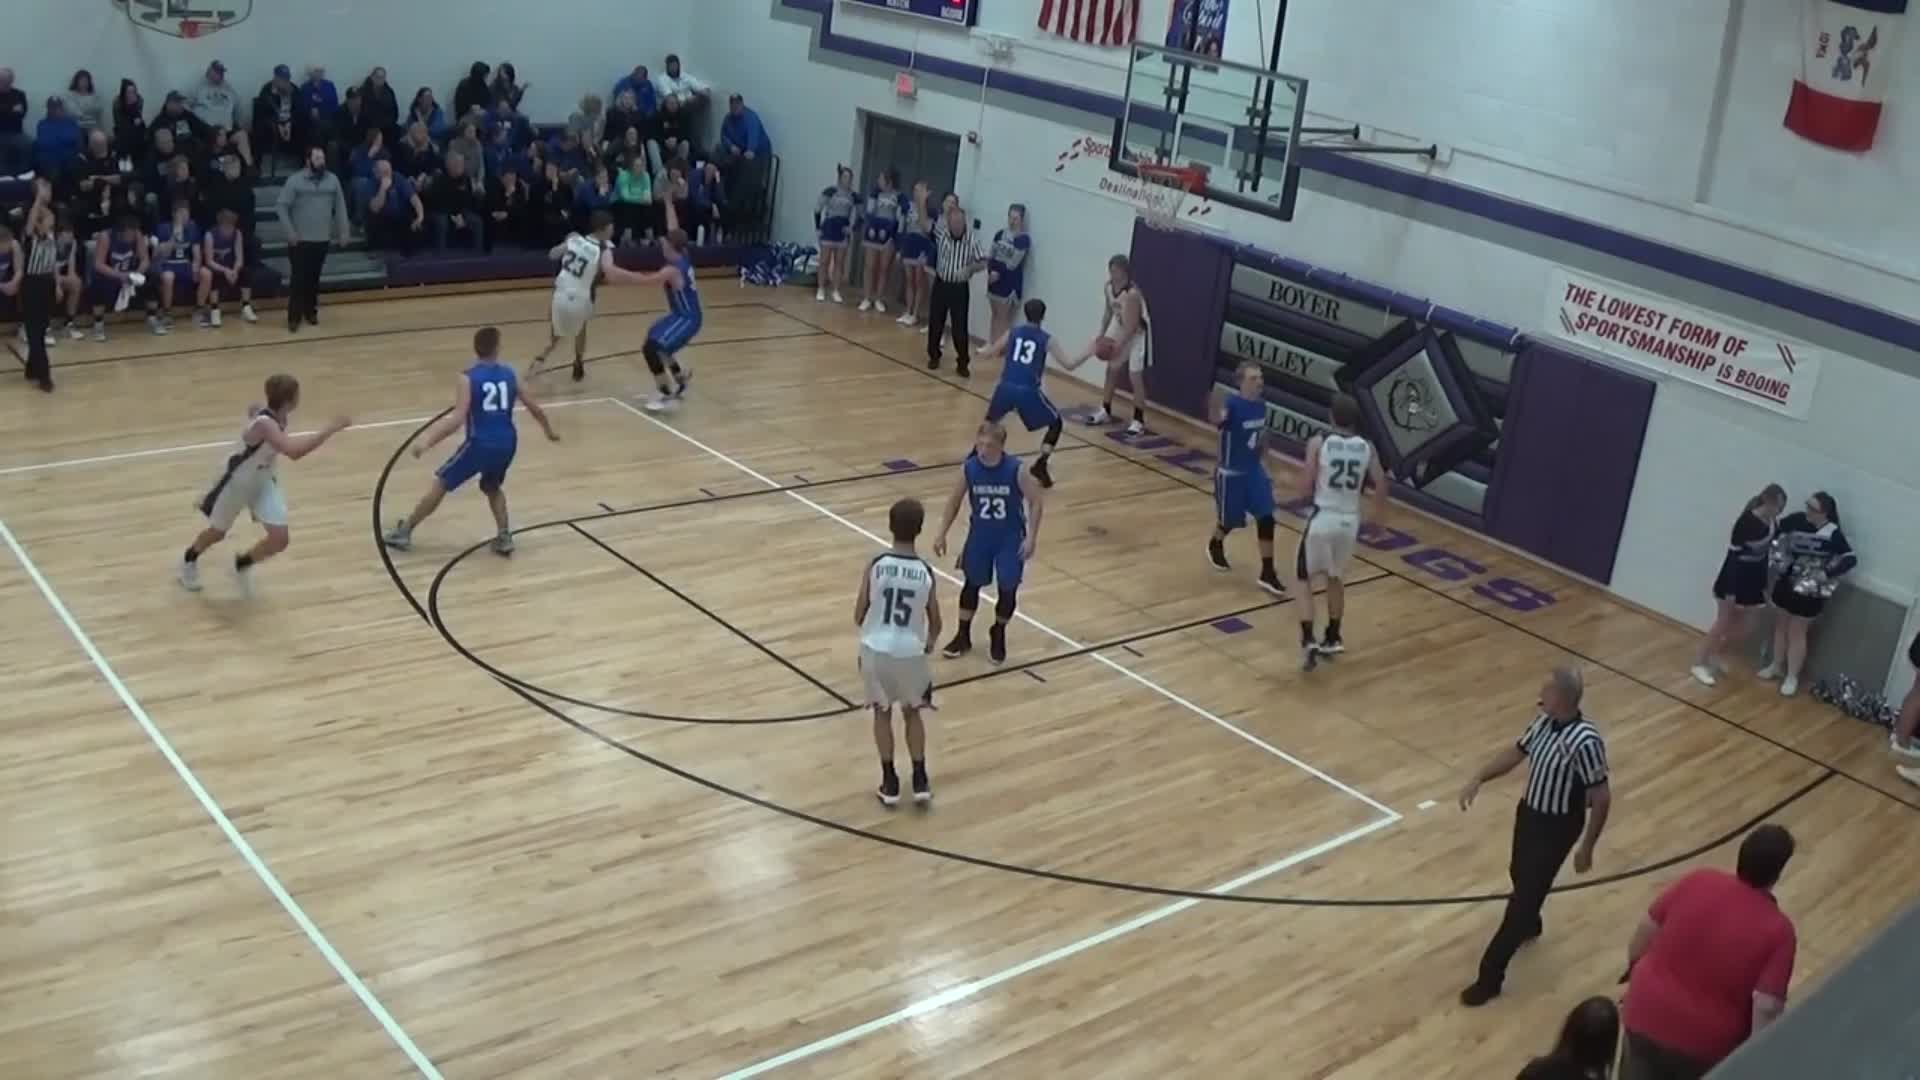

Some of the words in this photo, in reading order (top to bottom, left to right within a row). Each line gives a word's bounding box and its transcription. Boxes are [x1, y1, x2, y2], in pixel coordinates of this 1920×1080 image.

[562, 250, 588, 278] 23
[1268, 280, 1340, 321] BOYER
[1564, 283, 1597, 308] THE
[1597, 294, 1668, 331] LOWEST
[1668, 318, 1722, 349] FORM
[1723, 336, 1748, 357] OF
[1012, 337, 1037, 364] 13
[1235, 332, 1315, 375] VALLEY
[1575, 312, 1717, 372] SPORTSMANSHIP
[1717, 363, 1732, 379] IS
[1735, 370, 1790, 399] BOOING
[482, 381, 508, 411] 21
[1328, 458, 1361, 490] 25
[979, 496, 1007, 519] 23
[883, 587, 915, 627] 15
